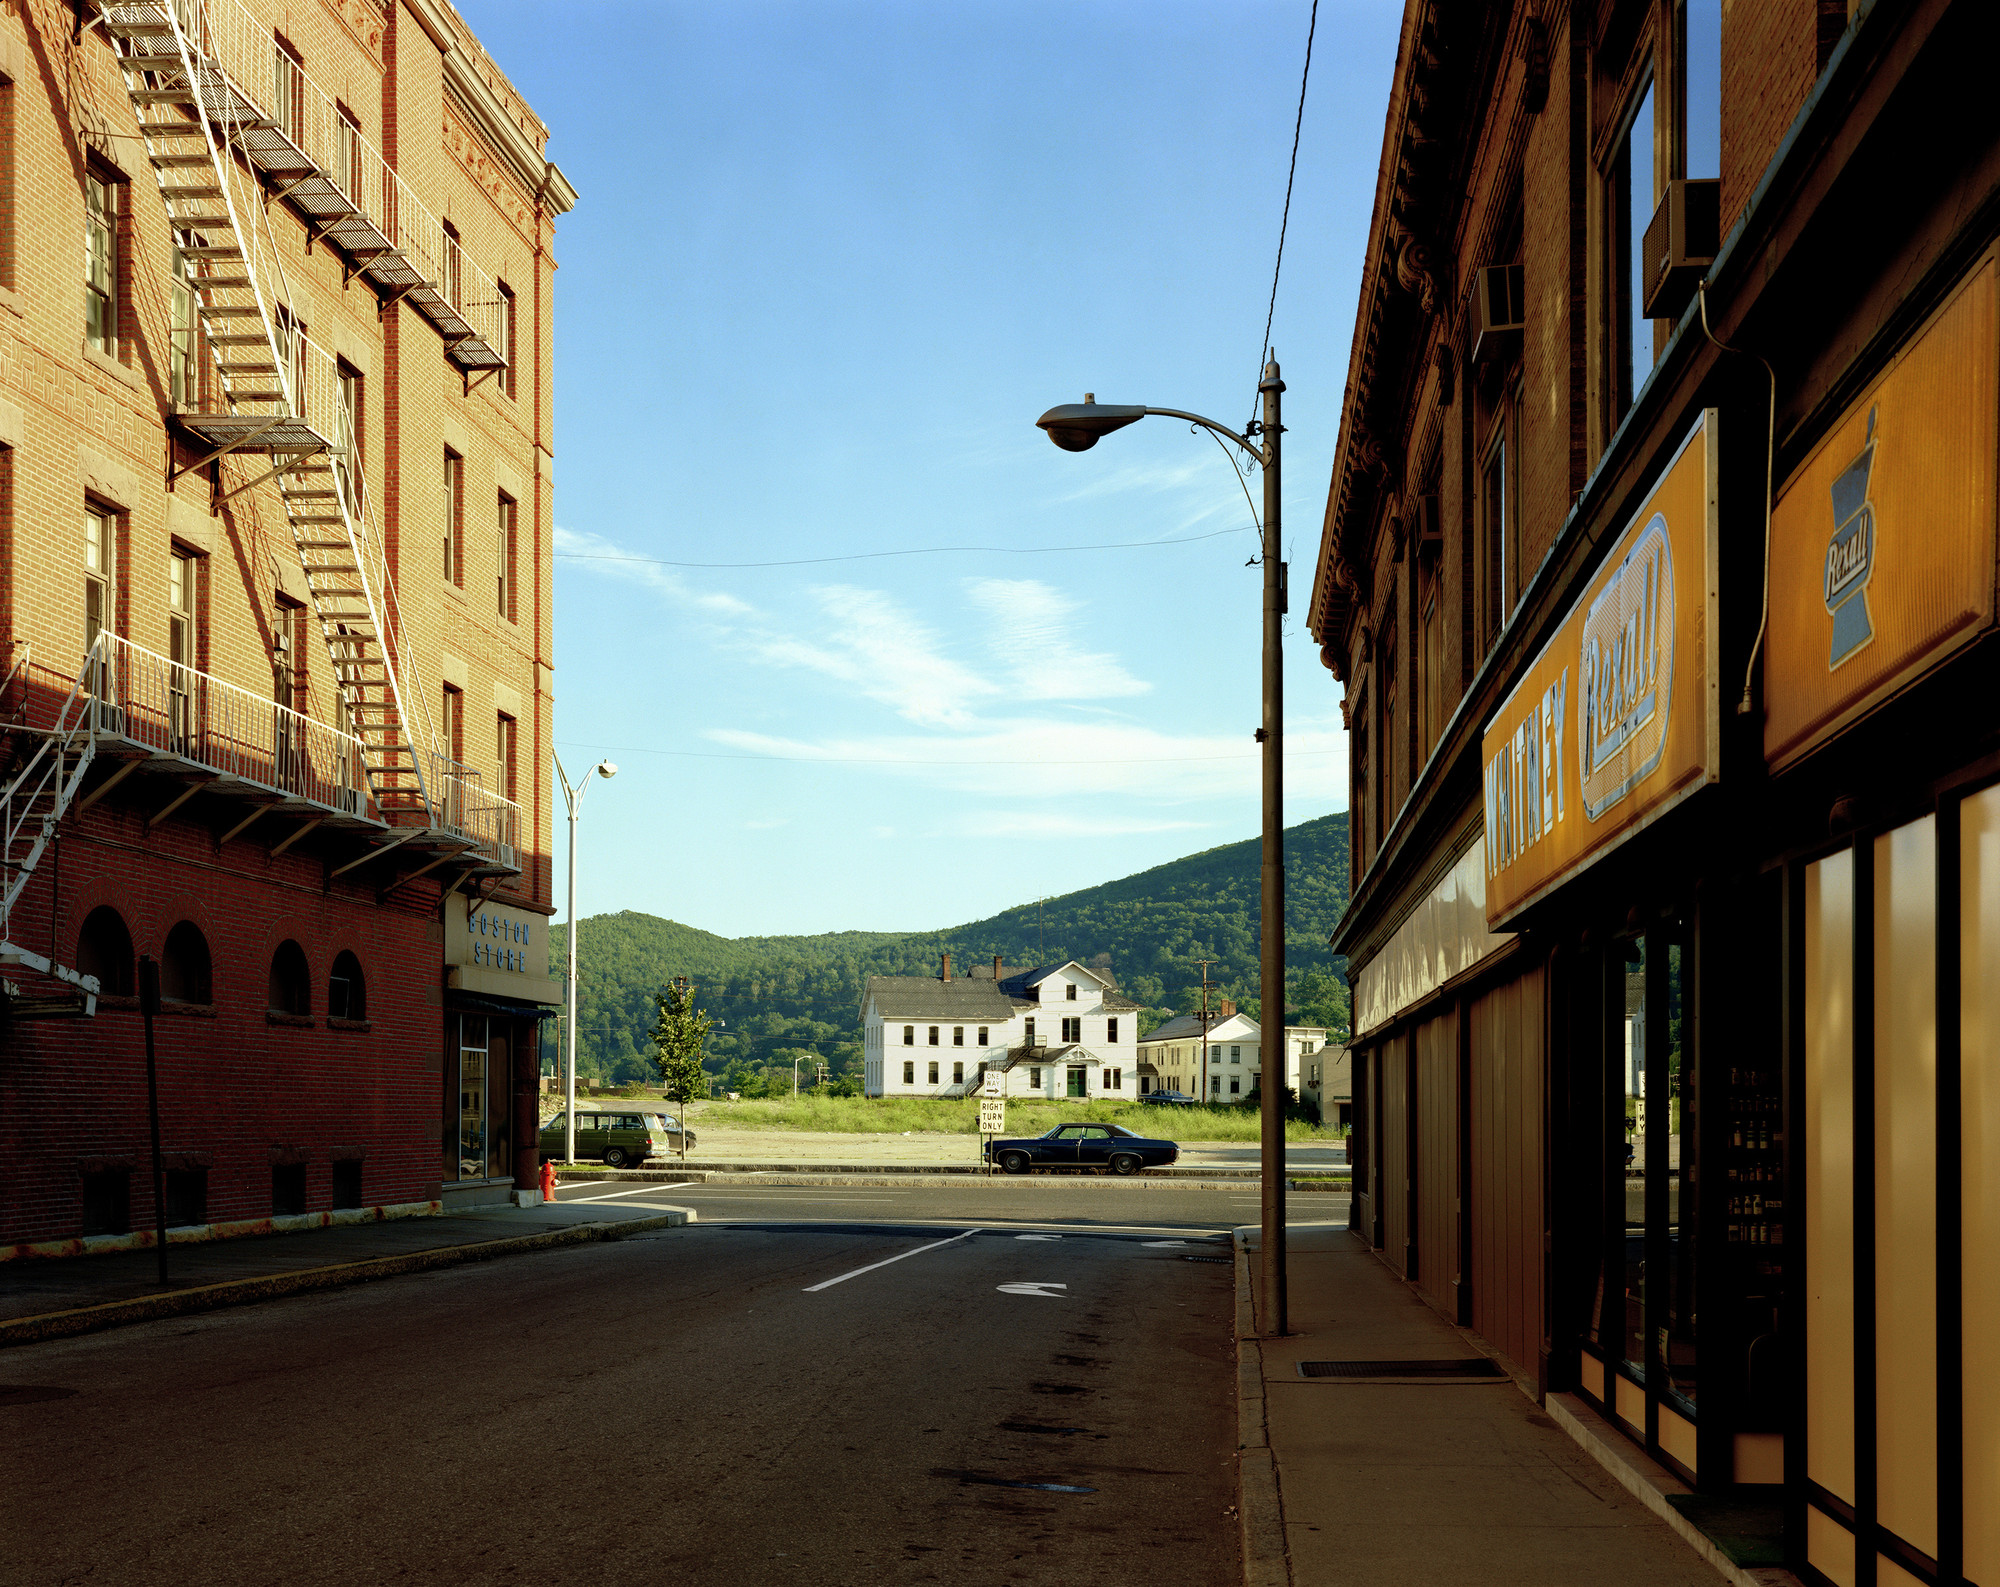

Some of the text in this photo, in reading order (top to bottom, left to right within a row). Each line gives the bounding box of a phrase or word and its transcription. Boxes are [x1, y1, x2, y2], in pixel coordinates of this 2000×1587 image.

[1825, 512, 1869, 602] Rexall
[1485, 546, 1662, 881] WHITNEY Rexall
[469, 912, 530, 945] BOSTON
[474, 941, 526, 973] STORE
[982, 1103, 1003, 1111] RIGHT
[983, 1113, 1003, 1121] TURN
[982, 1122, 1002, 1130] ONLY
